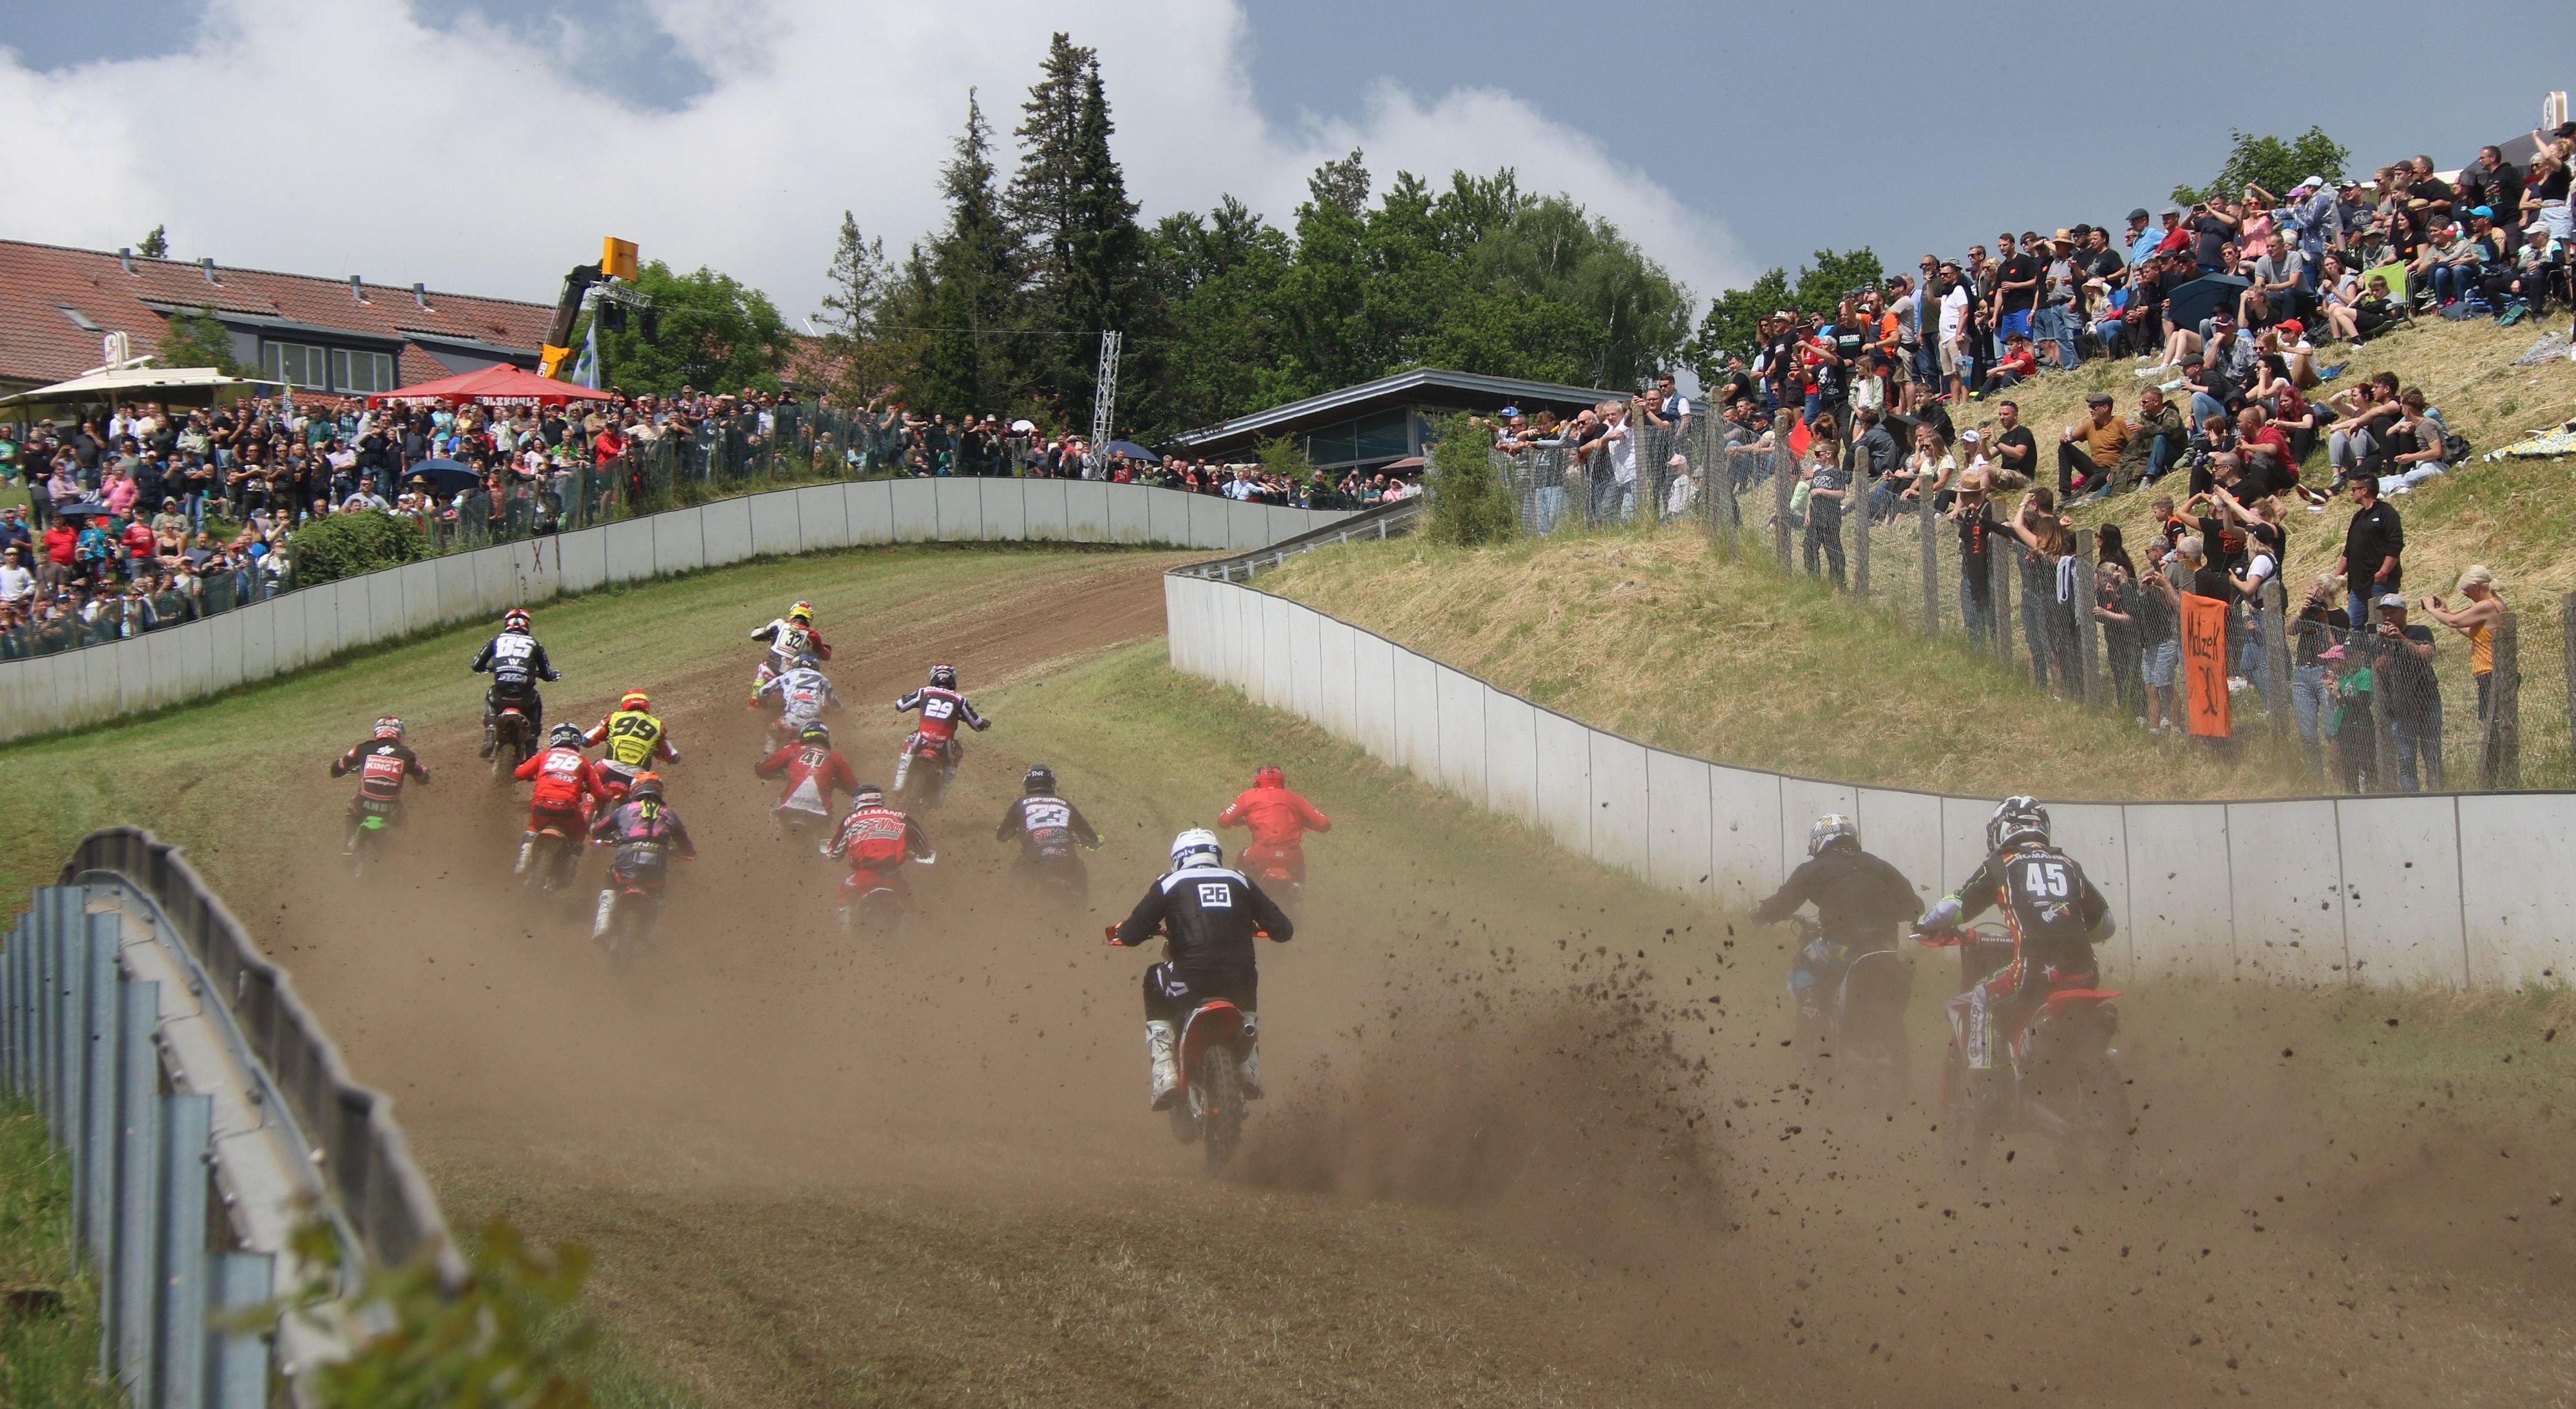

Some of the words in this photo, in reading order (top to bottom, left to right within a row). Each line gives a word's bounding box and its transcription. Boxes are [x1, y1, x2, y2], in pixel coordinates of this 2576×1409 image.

[475, 396, 540, 406] OLZKOHLE
[495, 636, 536, 658] 85
[785, 632, 802, 649] 32
[925, 698, 954, 719] 29
[612, 716, 658, 742] 99
[366, 762, 392, 771] KING
[368, 757, 394, 765] Sandwich
[544, 753, 583, 771] 58
[1025, 804, 1070, 830] 23
[2026, 862, 2068, 897] 45
[1202, 887, 1227, 903] 26
